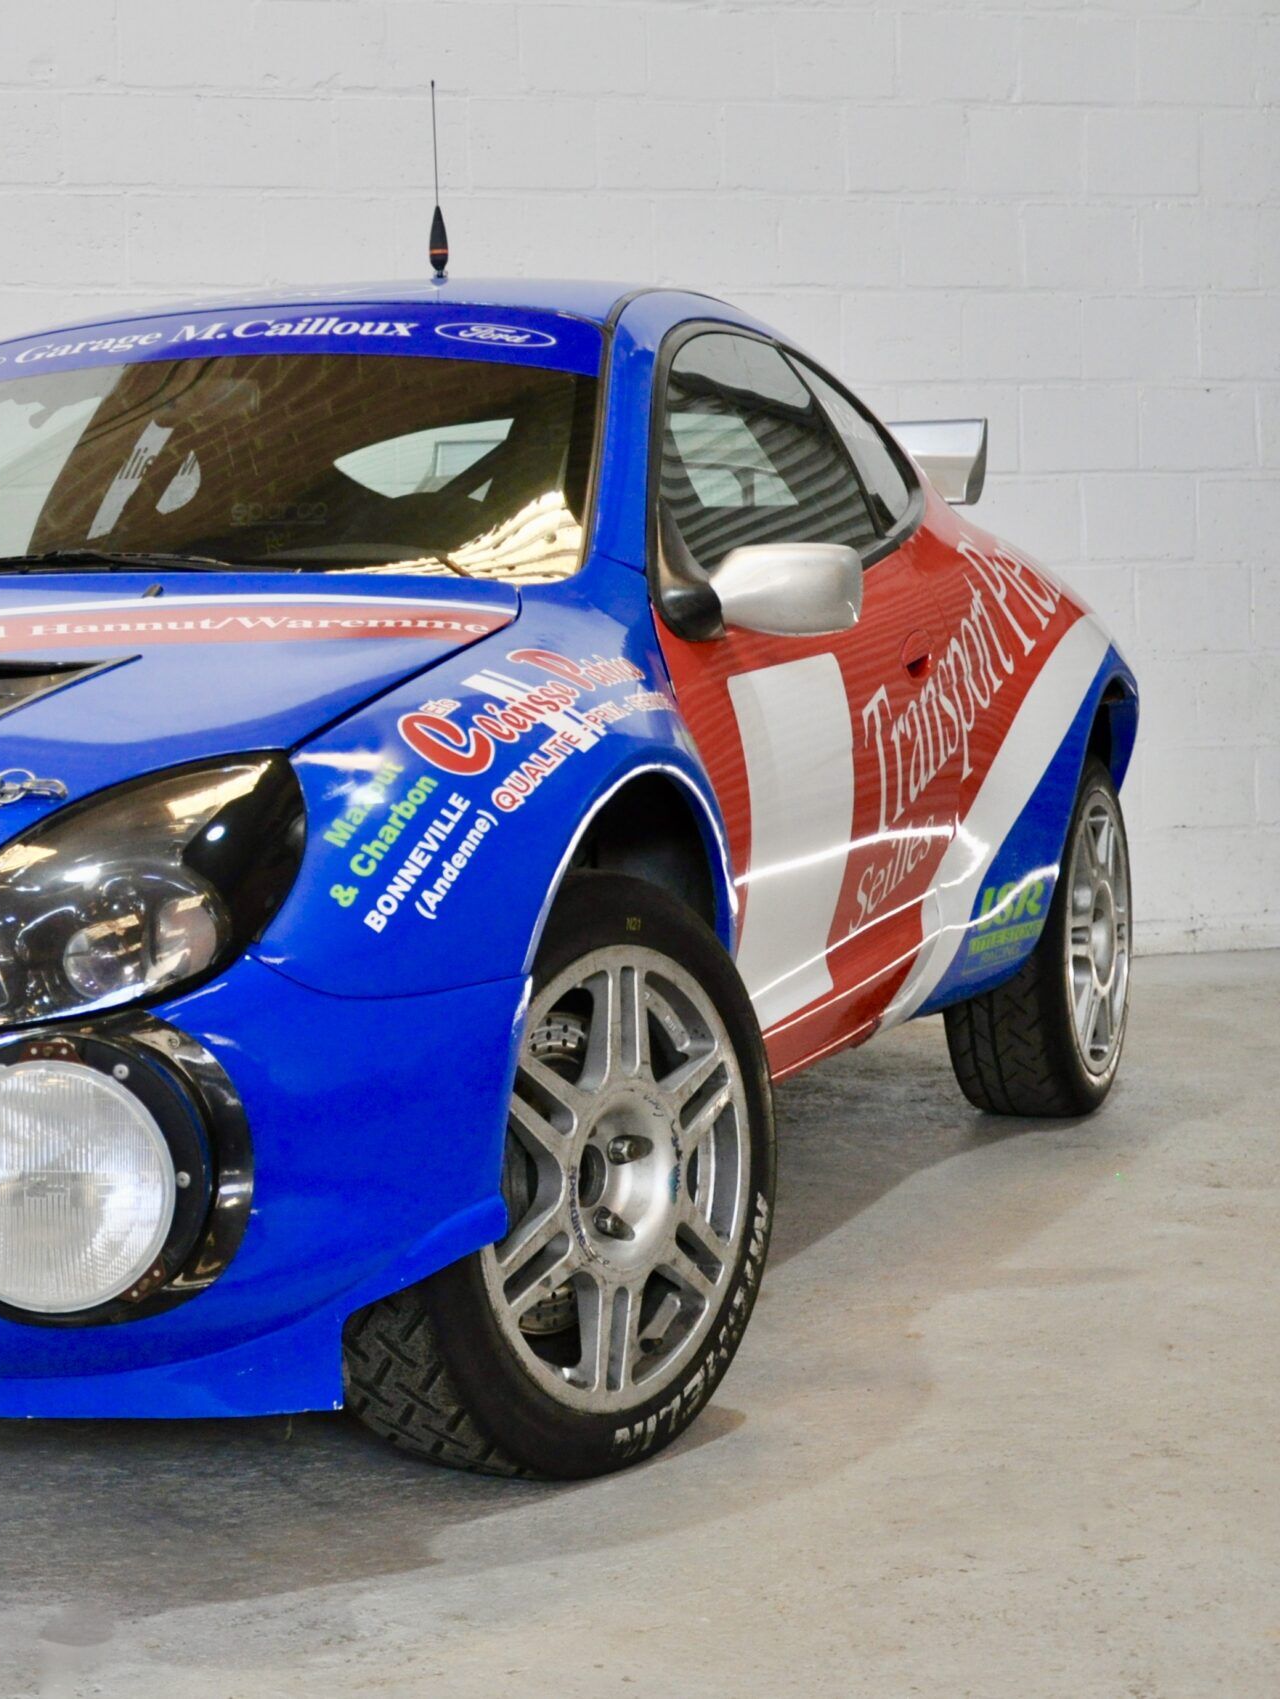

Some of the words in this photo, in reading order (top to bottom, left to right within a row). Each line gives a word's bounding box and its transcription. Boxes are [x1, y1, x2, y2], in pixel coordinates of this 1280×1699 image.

[15, 330, 162, 363] Garage
[170, 317, 421, 343] M.Cailloux
[31, 614, 490, 636] Hannut/Waremme
[421, 698, 461, 717] Ets
[861, 573, 1015, 832] Transport
[323, 762, 405, 848] Maout
[492, 730, 582, 812] QUALITE
[329, 883, 359, 908] &
[350, 776, 439, 877] Charbon
[363, 792, 471, 934] BONNEVILLE
[414, 809, 499, 920] (Andenne)
